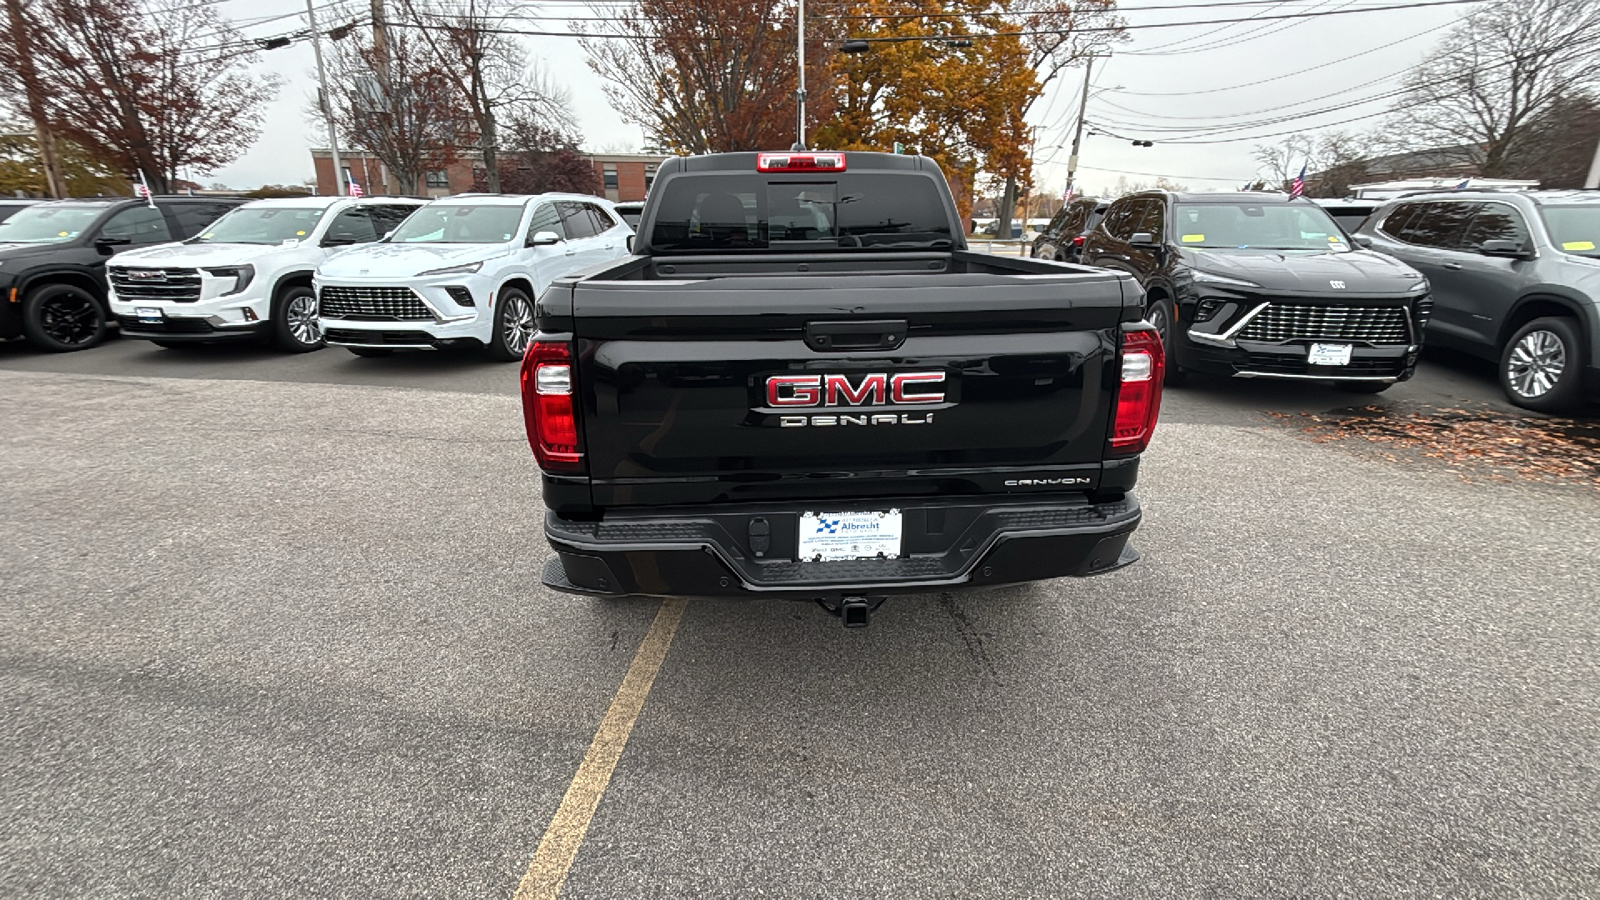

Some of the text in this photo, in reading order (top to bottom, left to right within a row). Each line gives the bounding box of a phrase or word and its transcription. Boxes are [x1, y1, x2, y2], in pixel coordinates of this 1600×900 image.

[766, 371, 946, 407] GMC
[780, 413, 934, 428] DENALI
[1004, 477, 1091, 486] CANYON
[841, 521, 880, 530] Albrecht
